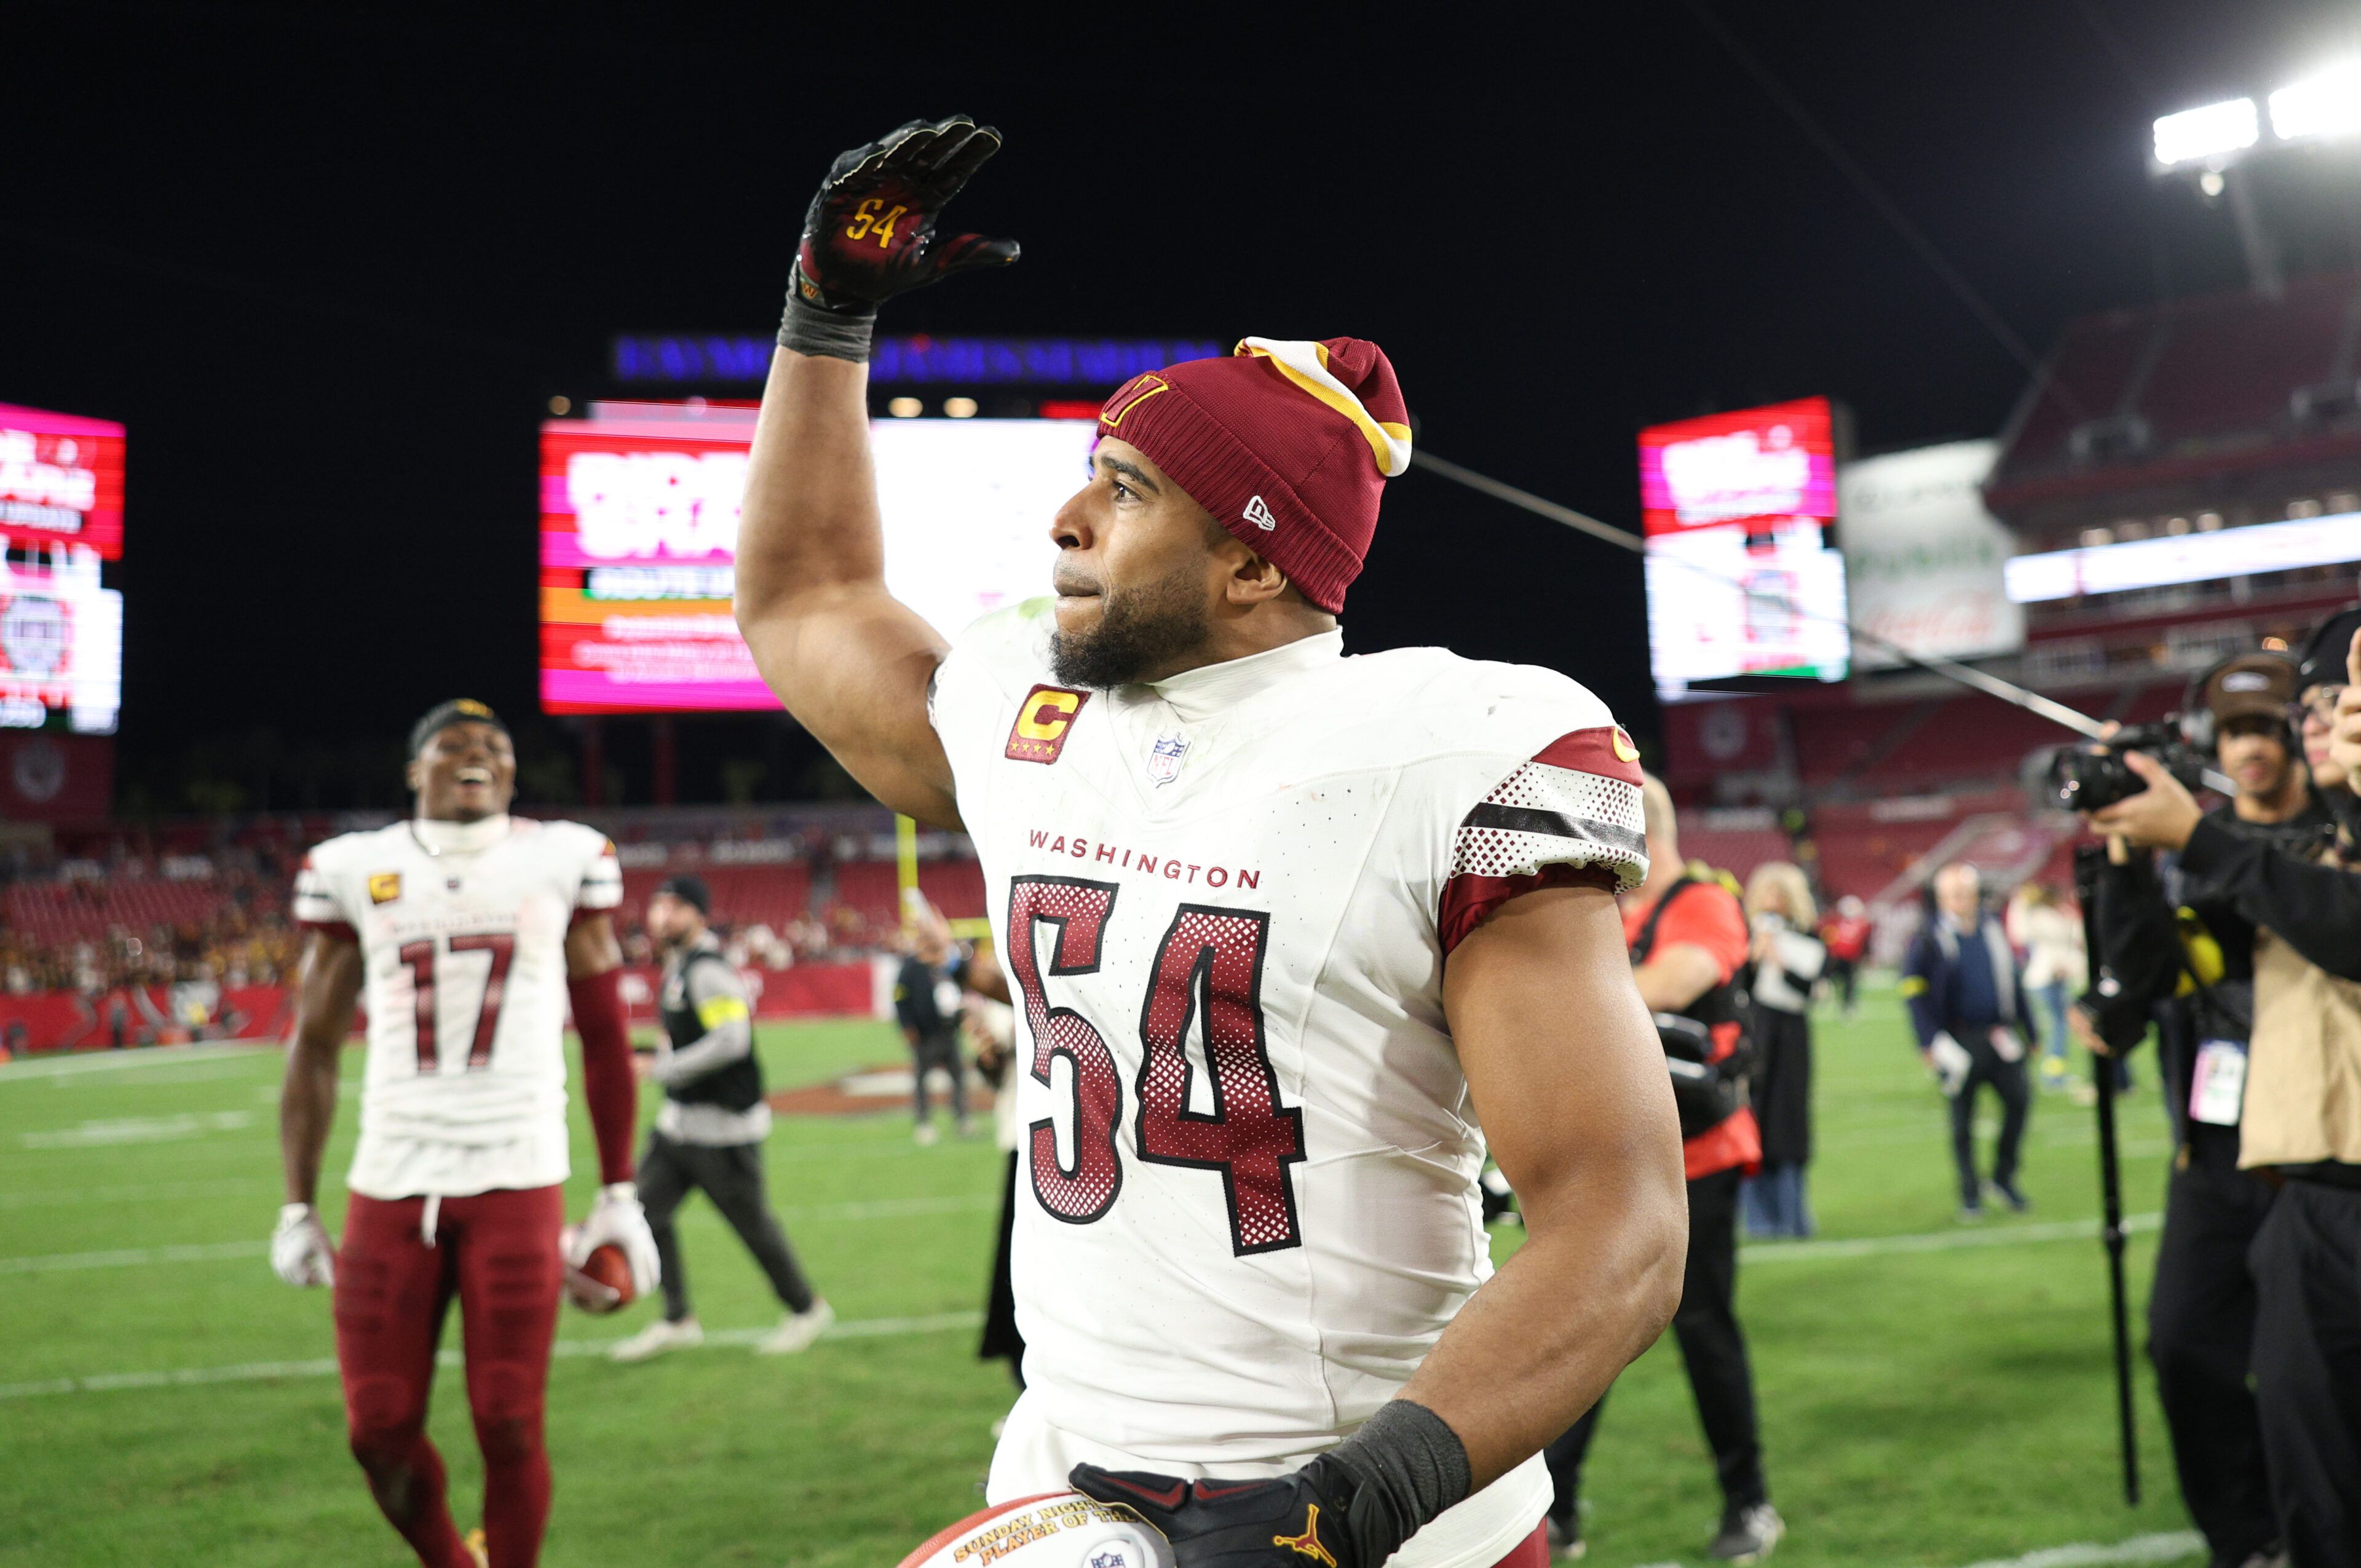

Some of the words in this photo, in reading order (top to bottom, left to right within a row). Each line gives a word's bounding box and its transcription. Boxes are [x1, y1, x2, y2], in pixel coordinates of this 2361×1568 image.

[846, 198, 908, 249] 54
[1017, 690, 1079, 741] C
[1030, 829, 1261, 889] WASHINGTON
[400, 933, 515, 1072] 17
[1006, 875, 1307, 1257] 54
[954, 1513, 1032, 1562] SUNDAY
[979, 1521, 1059, 1566] PLAYER
[1062, 1512, 1088, 1528] OF
